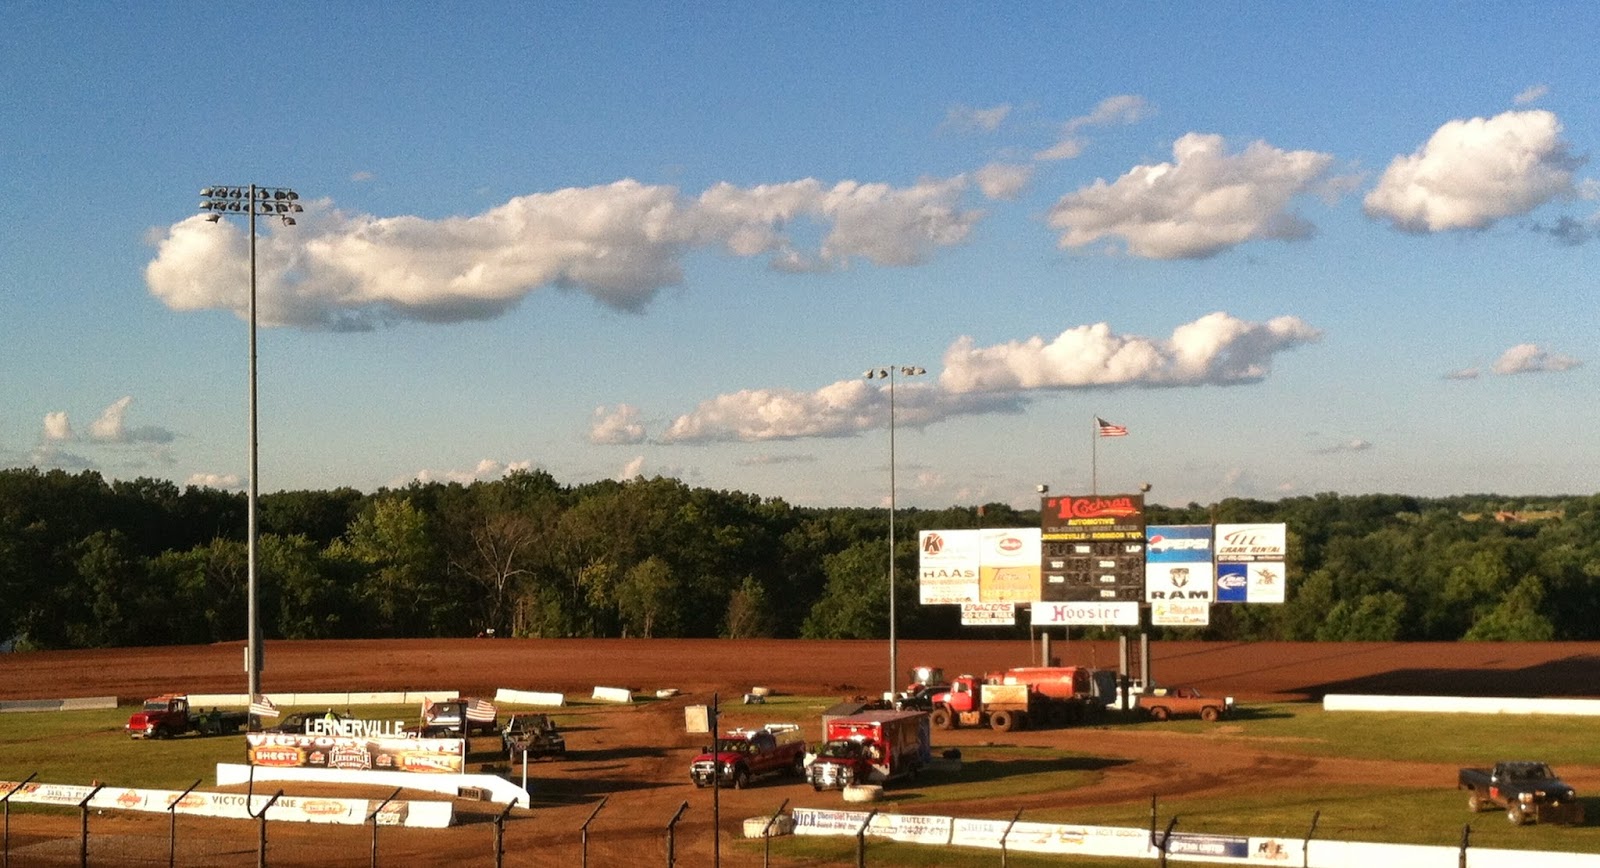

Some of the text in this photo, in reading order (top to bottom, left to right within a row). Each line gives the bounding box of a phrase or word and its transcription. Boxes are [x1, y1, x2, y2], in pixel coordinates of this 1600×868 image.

[1071, 496, 1137, 518] Cochran
[1067, 518, 1116, 526] AUTOMOTIVE
[1125, 545, 1142, 553] LAP
[1163, 538, 1210, 550] PEPSI
[923, 569, 976, 578] HAAS
[1048, 575, 1065, 583] 2ND
[1150, 590, 1209, 600] RAM
[1050, 605, 1120, 622] Hoosier
[305, 718, 405, 739] LERNERVILLE
[247, 734, 370, 748] VICTORY
[255, 751, 298, 761] SHEETZ
